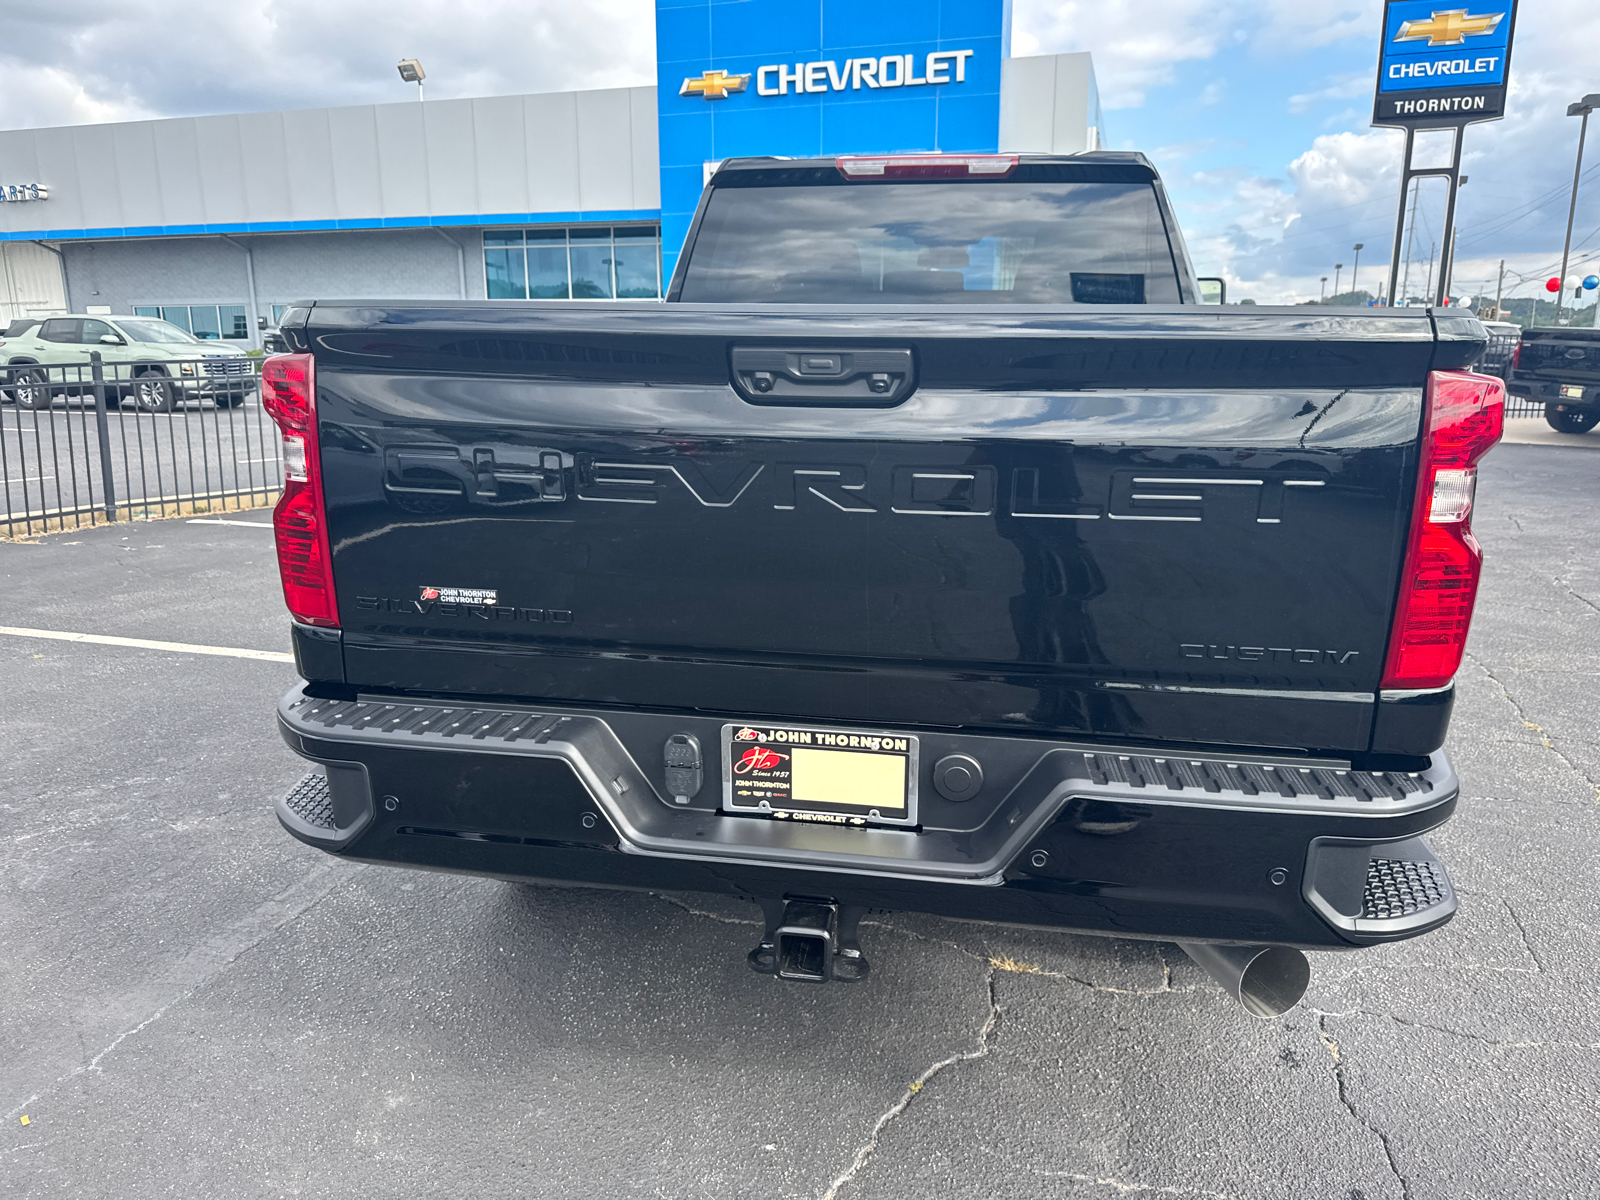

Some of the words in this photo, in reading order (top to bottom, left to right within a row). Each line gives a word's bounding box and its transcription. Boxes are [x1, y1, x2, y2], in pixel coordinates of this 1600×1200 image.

[757, 50, 974, 96] CHEVROLET
[1389, 57, 1499, 78] CHEVROLET
[1394, 96, 1485, 114] THORNTON
[382, 444, 1331, 524] CHEVROLET
[440, 596, 482, 604] CHEVROLET
[459, 590, 497, 598] THORNTON
[356, 596, 574, 623] SILVERADO
[1179, 643, 1359, 664] CUSTOM
[767, 730, 811, 744] JOHN
[815, 733, 907, 750] THORNTON
[752, 769, 770, 777] Since
[753, 781, 789, 789] THORNTON
[792, 812, 846, 823] CHEVROLET
